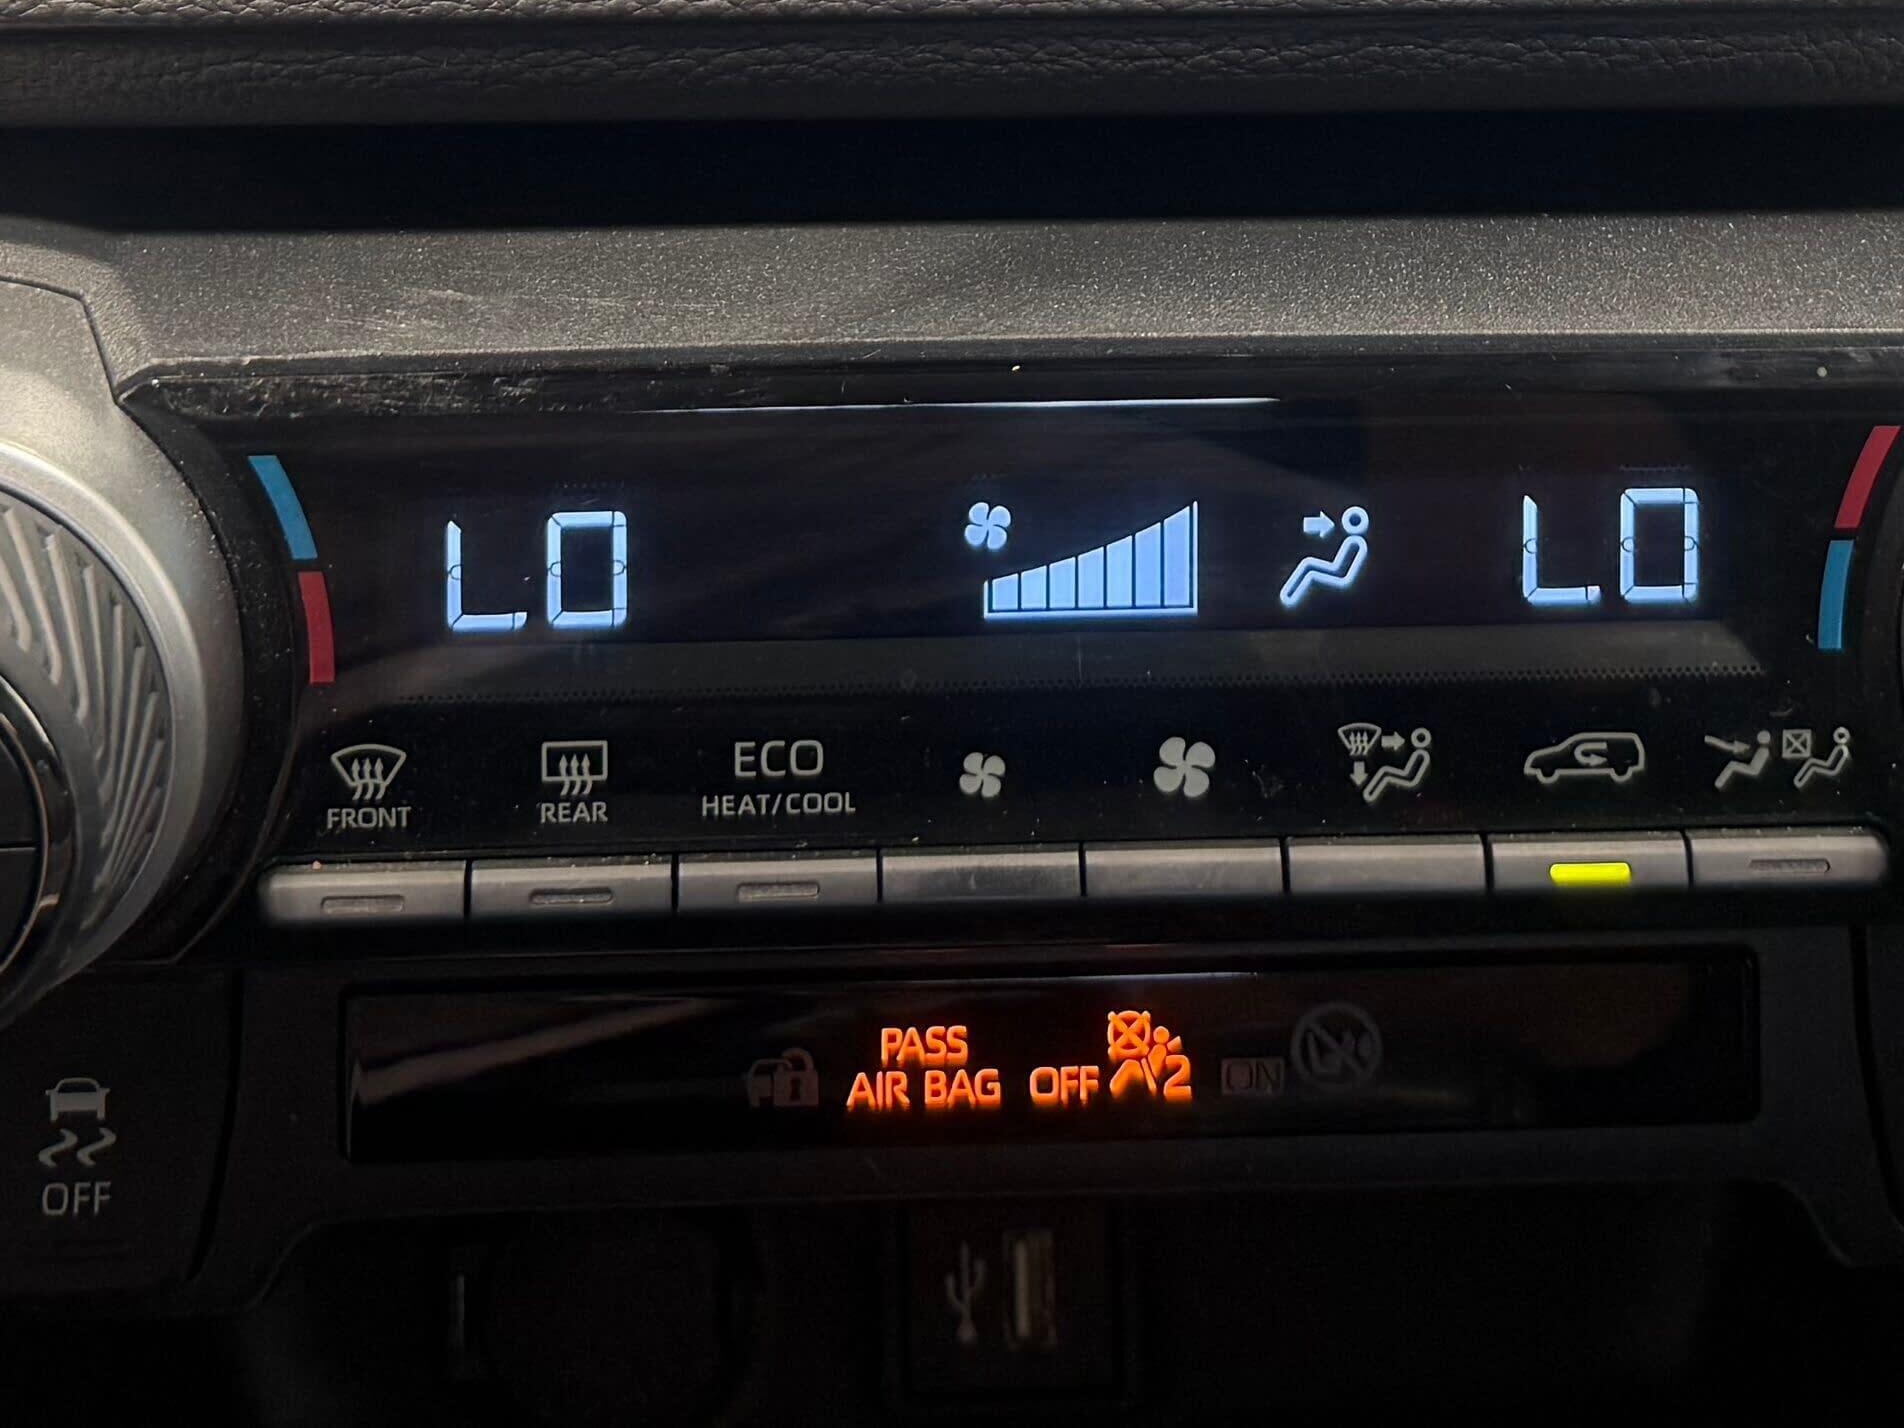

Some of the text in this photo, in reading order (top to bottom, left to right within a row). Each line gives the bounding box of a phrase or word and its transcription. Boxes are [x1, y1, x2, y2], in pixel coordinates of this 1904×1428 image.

[1521, 487, 1700, 606] LO
[445, 510, 628, 633] LO
[734, 739, 824, 778] ECO
[326, 806, 412, 830] FRONT
[540, 801, 608, 824] REAR
[701, 792, 856, 817] HEAT/COOL
[881, 1025, 968, 1064] PASS
[847, 1064, 1099, 1108] AIR BAG OFF
[41, 1181, 111, 1216] OFF
